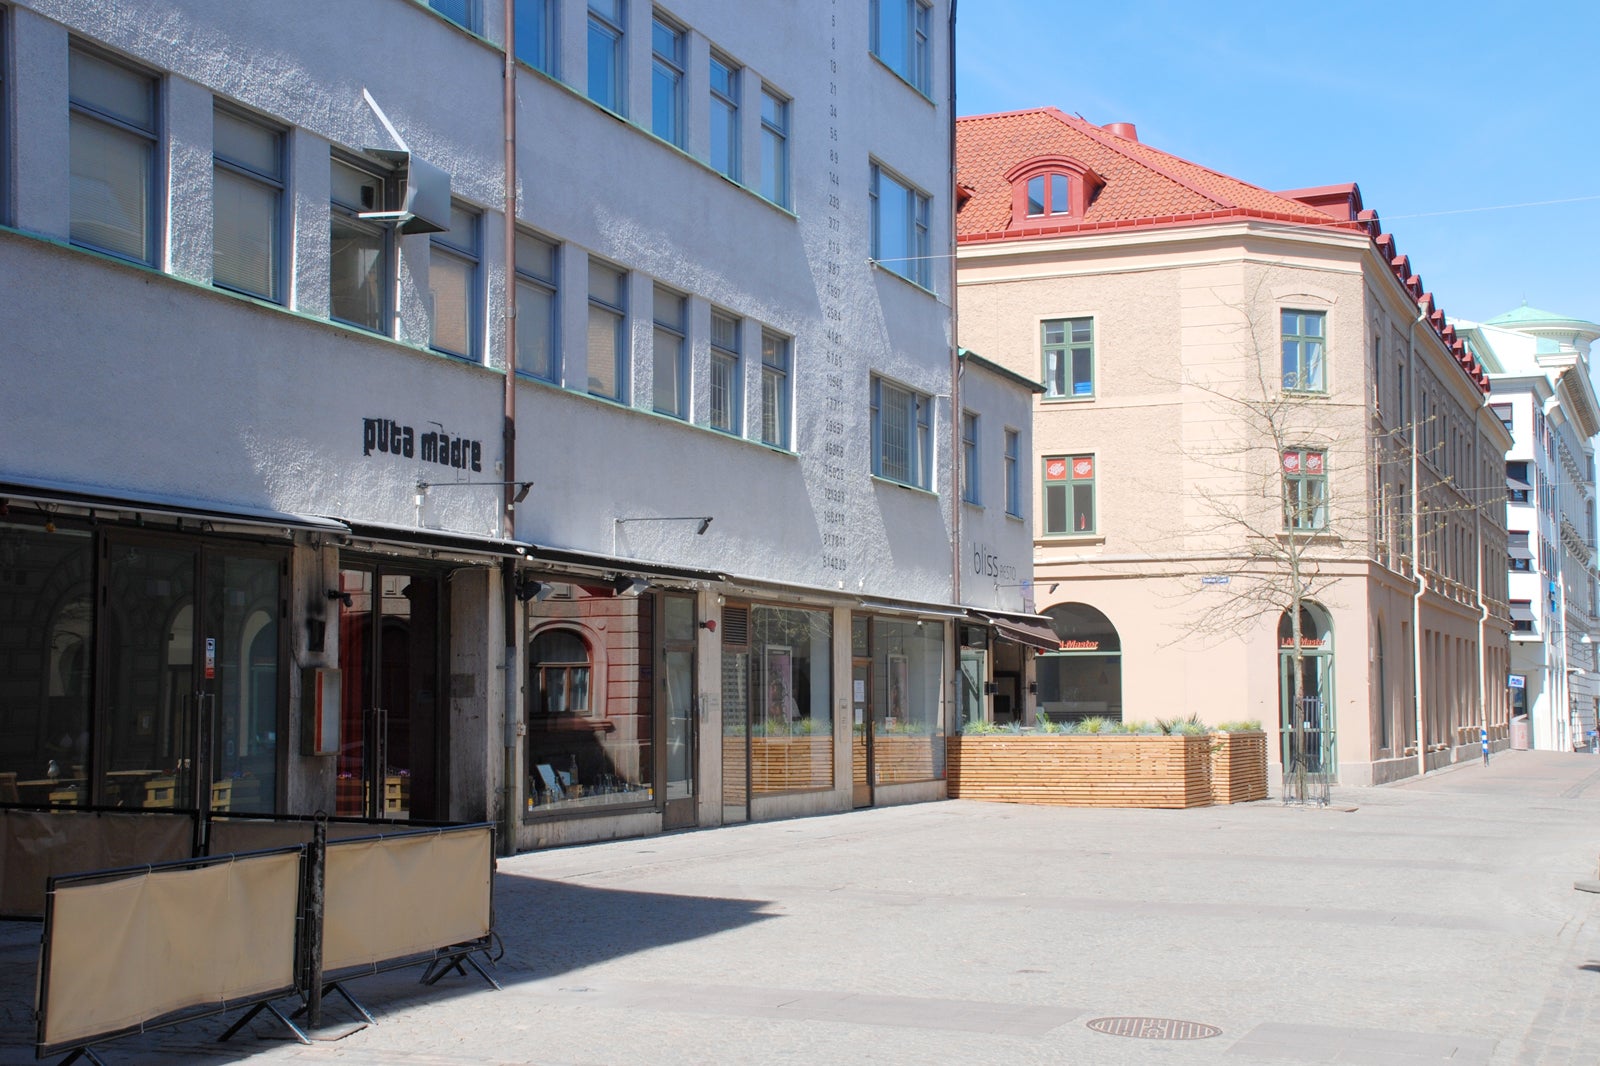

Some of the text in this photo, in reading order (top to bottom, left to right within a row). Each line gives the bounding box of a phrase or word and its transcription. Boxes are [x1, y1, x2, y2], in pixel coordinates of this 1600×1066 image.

[830, 59, 837, 74] 13
[830, 82, 837, 96] 21
[830, 104, 837, 118] 34
[830, 126, 838, 141] 55
[829, 149, 839, 164] 89
[829, 171, 840, 187] 144
[828, 194, 840, 210] 233
[828, 216, 840, 232] 377
[828, 261, 841, 277] 987
[827, 306, 841, 321] 2584
[827, 329, 842, 346] 4181
[826, 351, 843, 368] 6765
[363, 418, 482, 473] puta madre
[973, 541, 999, 578] bliss
